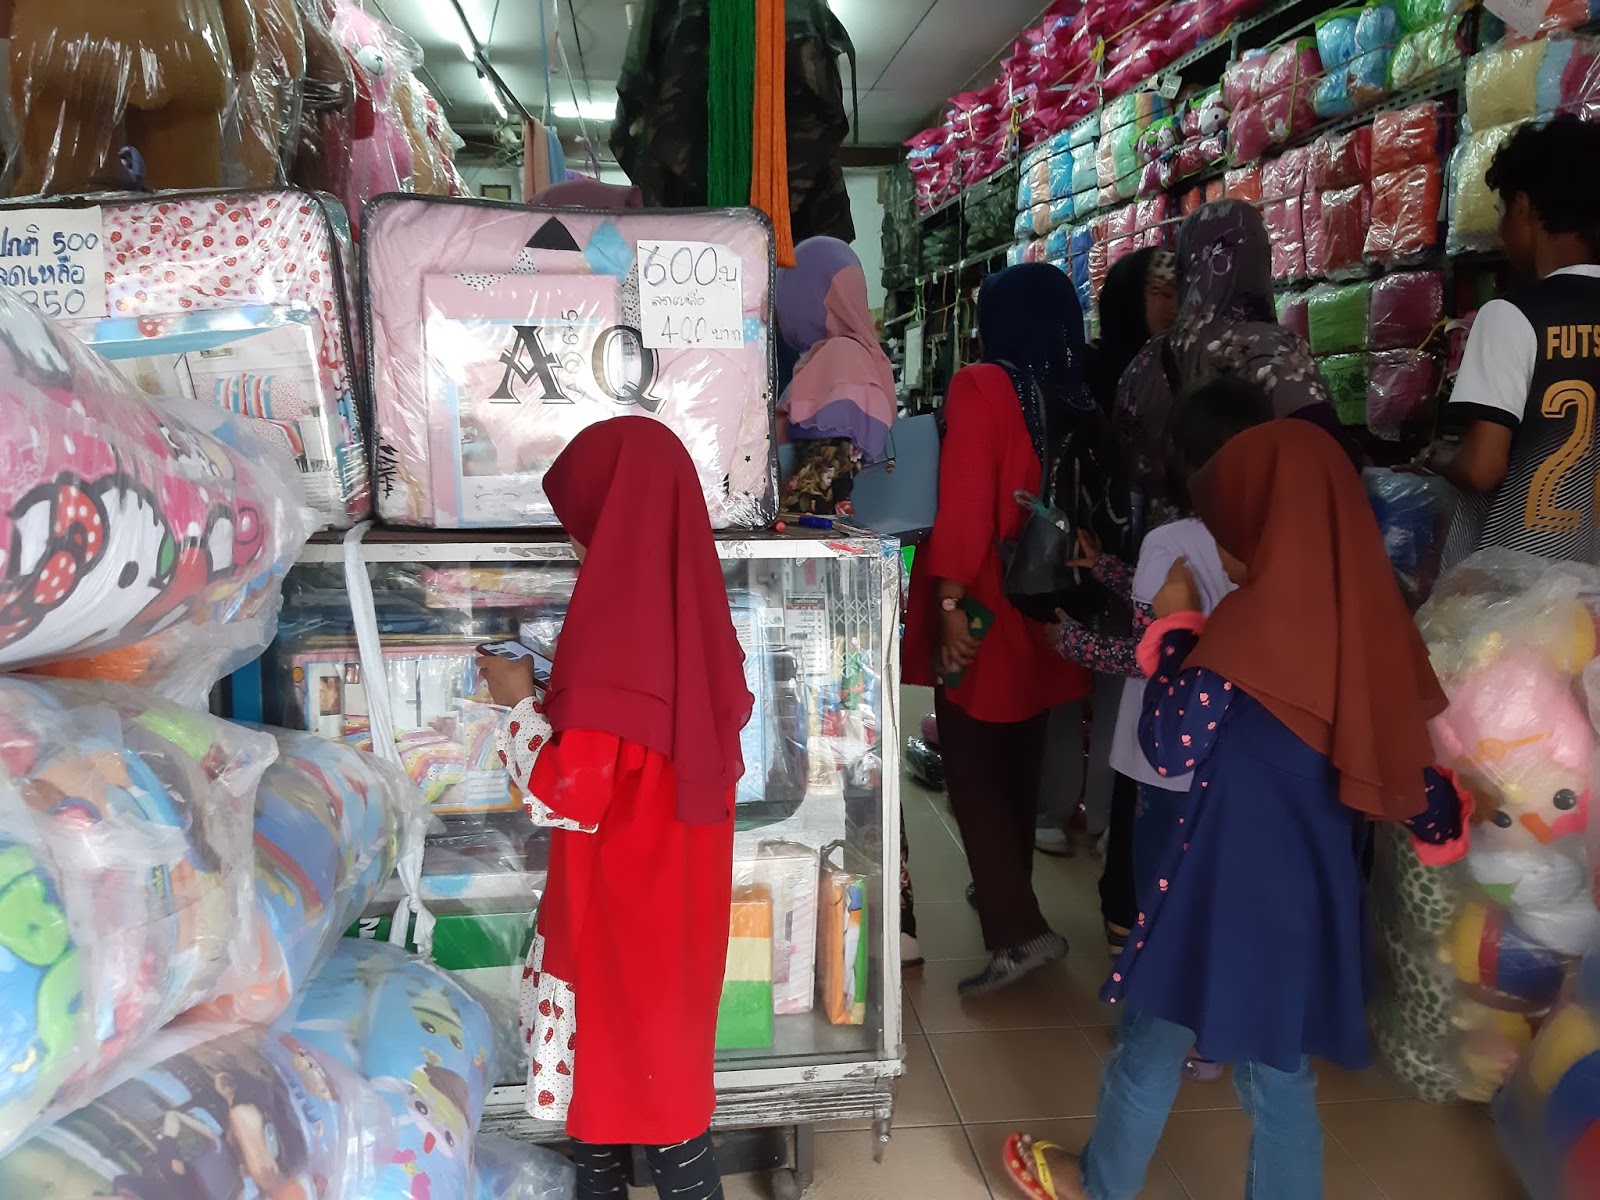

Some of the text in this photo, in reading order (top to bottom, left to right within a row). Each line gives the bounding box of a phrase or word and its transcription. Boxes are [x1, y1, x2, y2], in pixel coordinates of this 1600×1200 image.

[53, 231, 99, 255] 500
[661, 315, 741, 343] 400 บาท
[1524, 379, 1600, 532] 2
